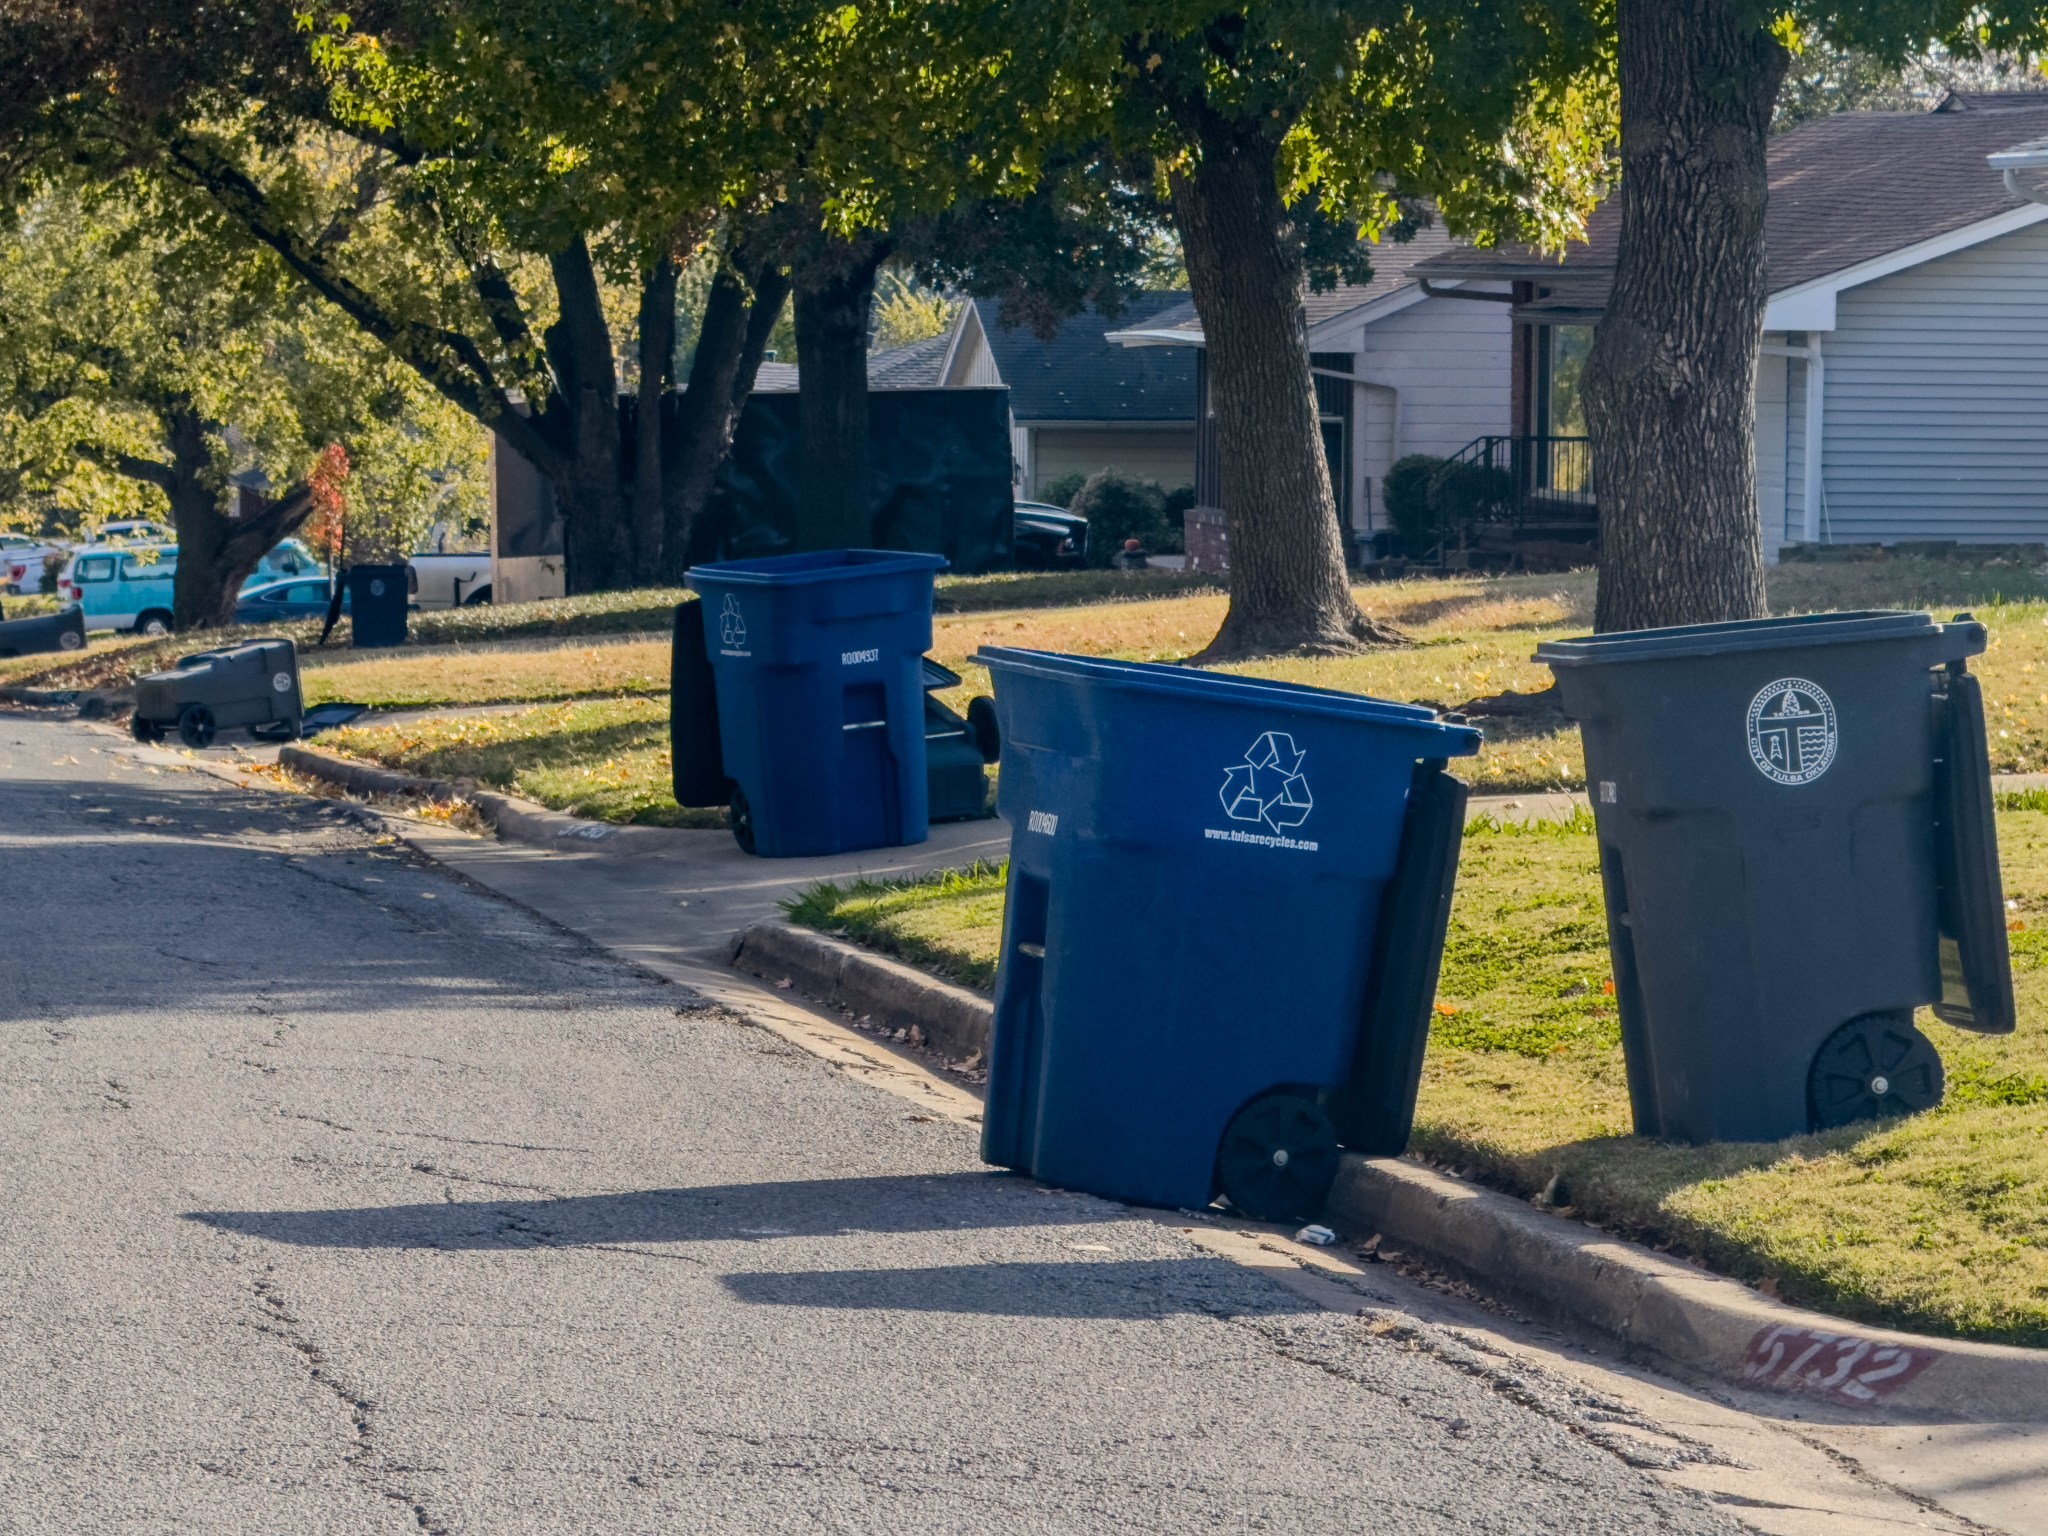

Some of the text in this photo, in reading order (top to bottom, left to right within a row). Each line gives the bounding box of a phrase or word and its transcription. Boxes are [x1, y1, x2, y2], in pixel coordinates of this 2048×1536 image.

[1750, 731, 1835, 782] CITY OF TULSA OKLAHOMA
[1204, 828, 1319, 851] www.tulsarecycles.com
[1744, 1326, 1913, 1400] 5732
